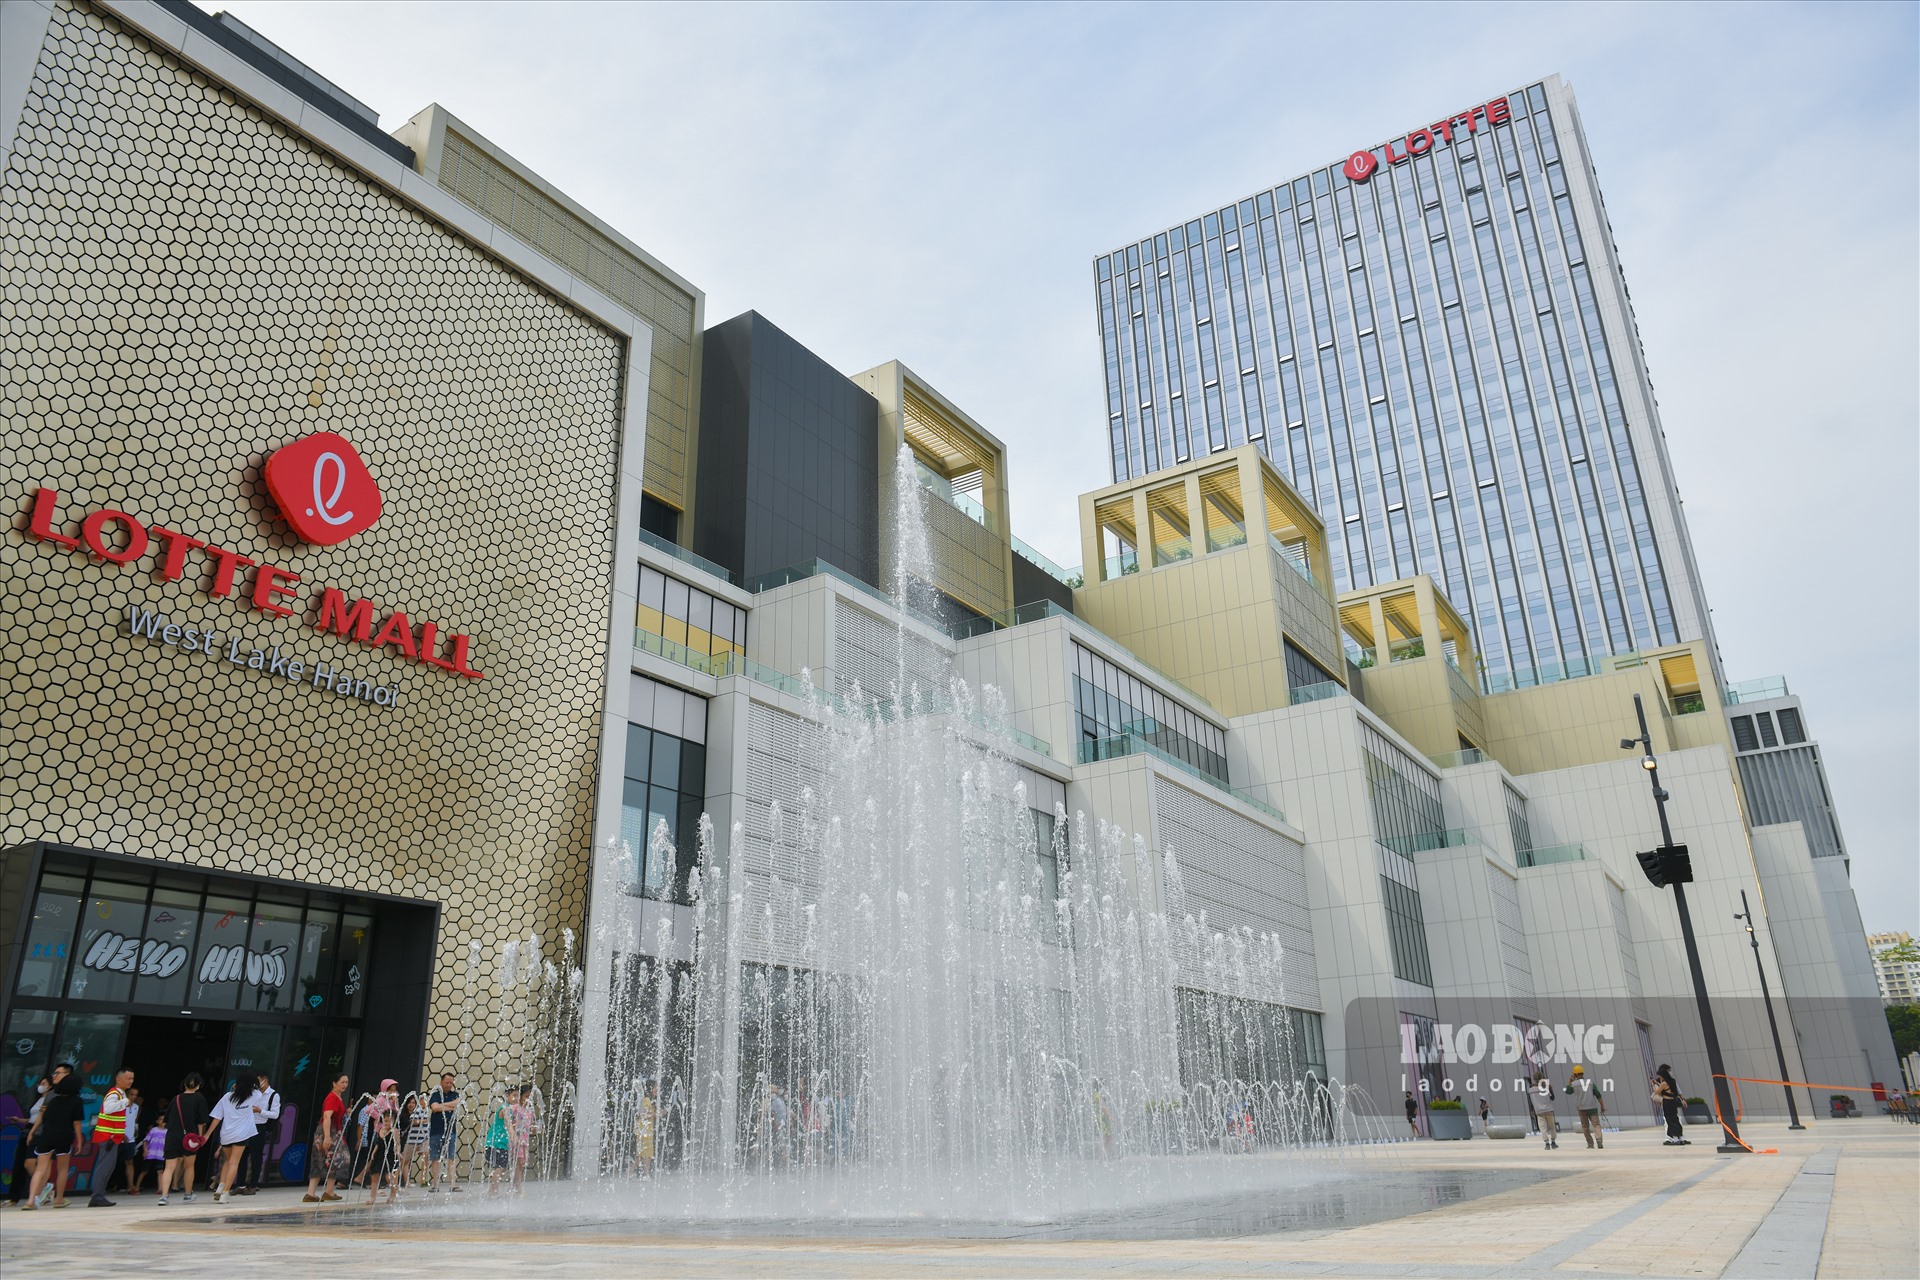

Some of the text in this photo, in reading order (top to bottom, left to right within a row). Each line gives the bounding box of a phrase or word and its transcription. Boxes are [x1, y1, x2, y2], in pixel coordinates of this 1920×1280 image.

[1384, 97, 1511, 164] LOTTE
[29, 487, 485, 679] LOTTE MALL
[130, 606, 400, 708] West Lake Hanoi
[83, 930, 189, 979] HELLO
